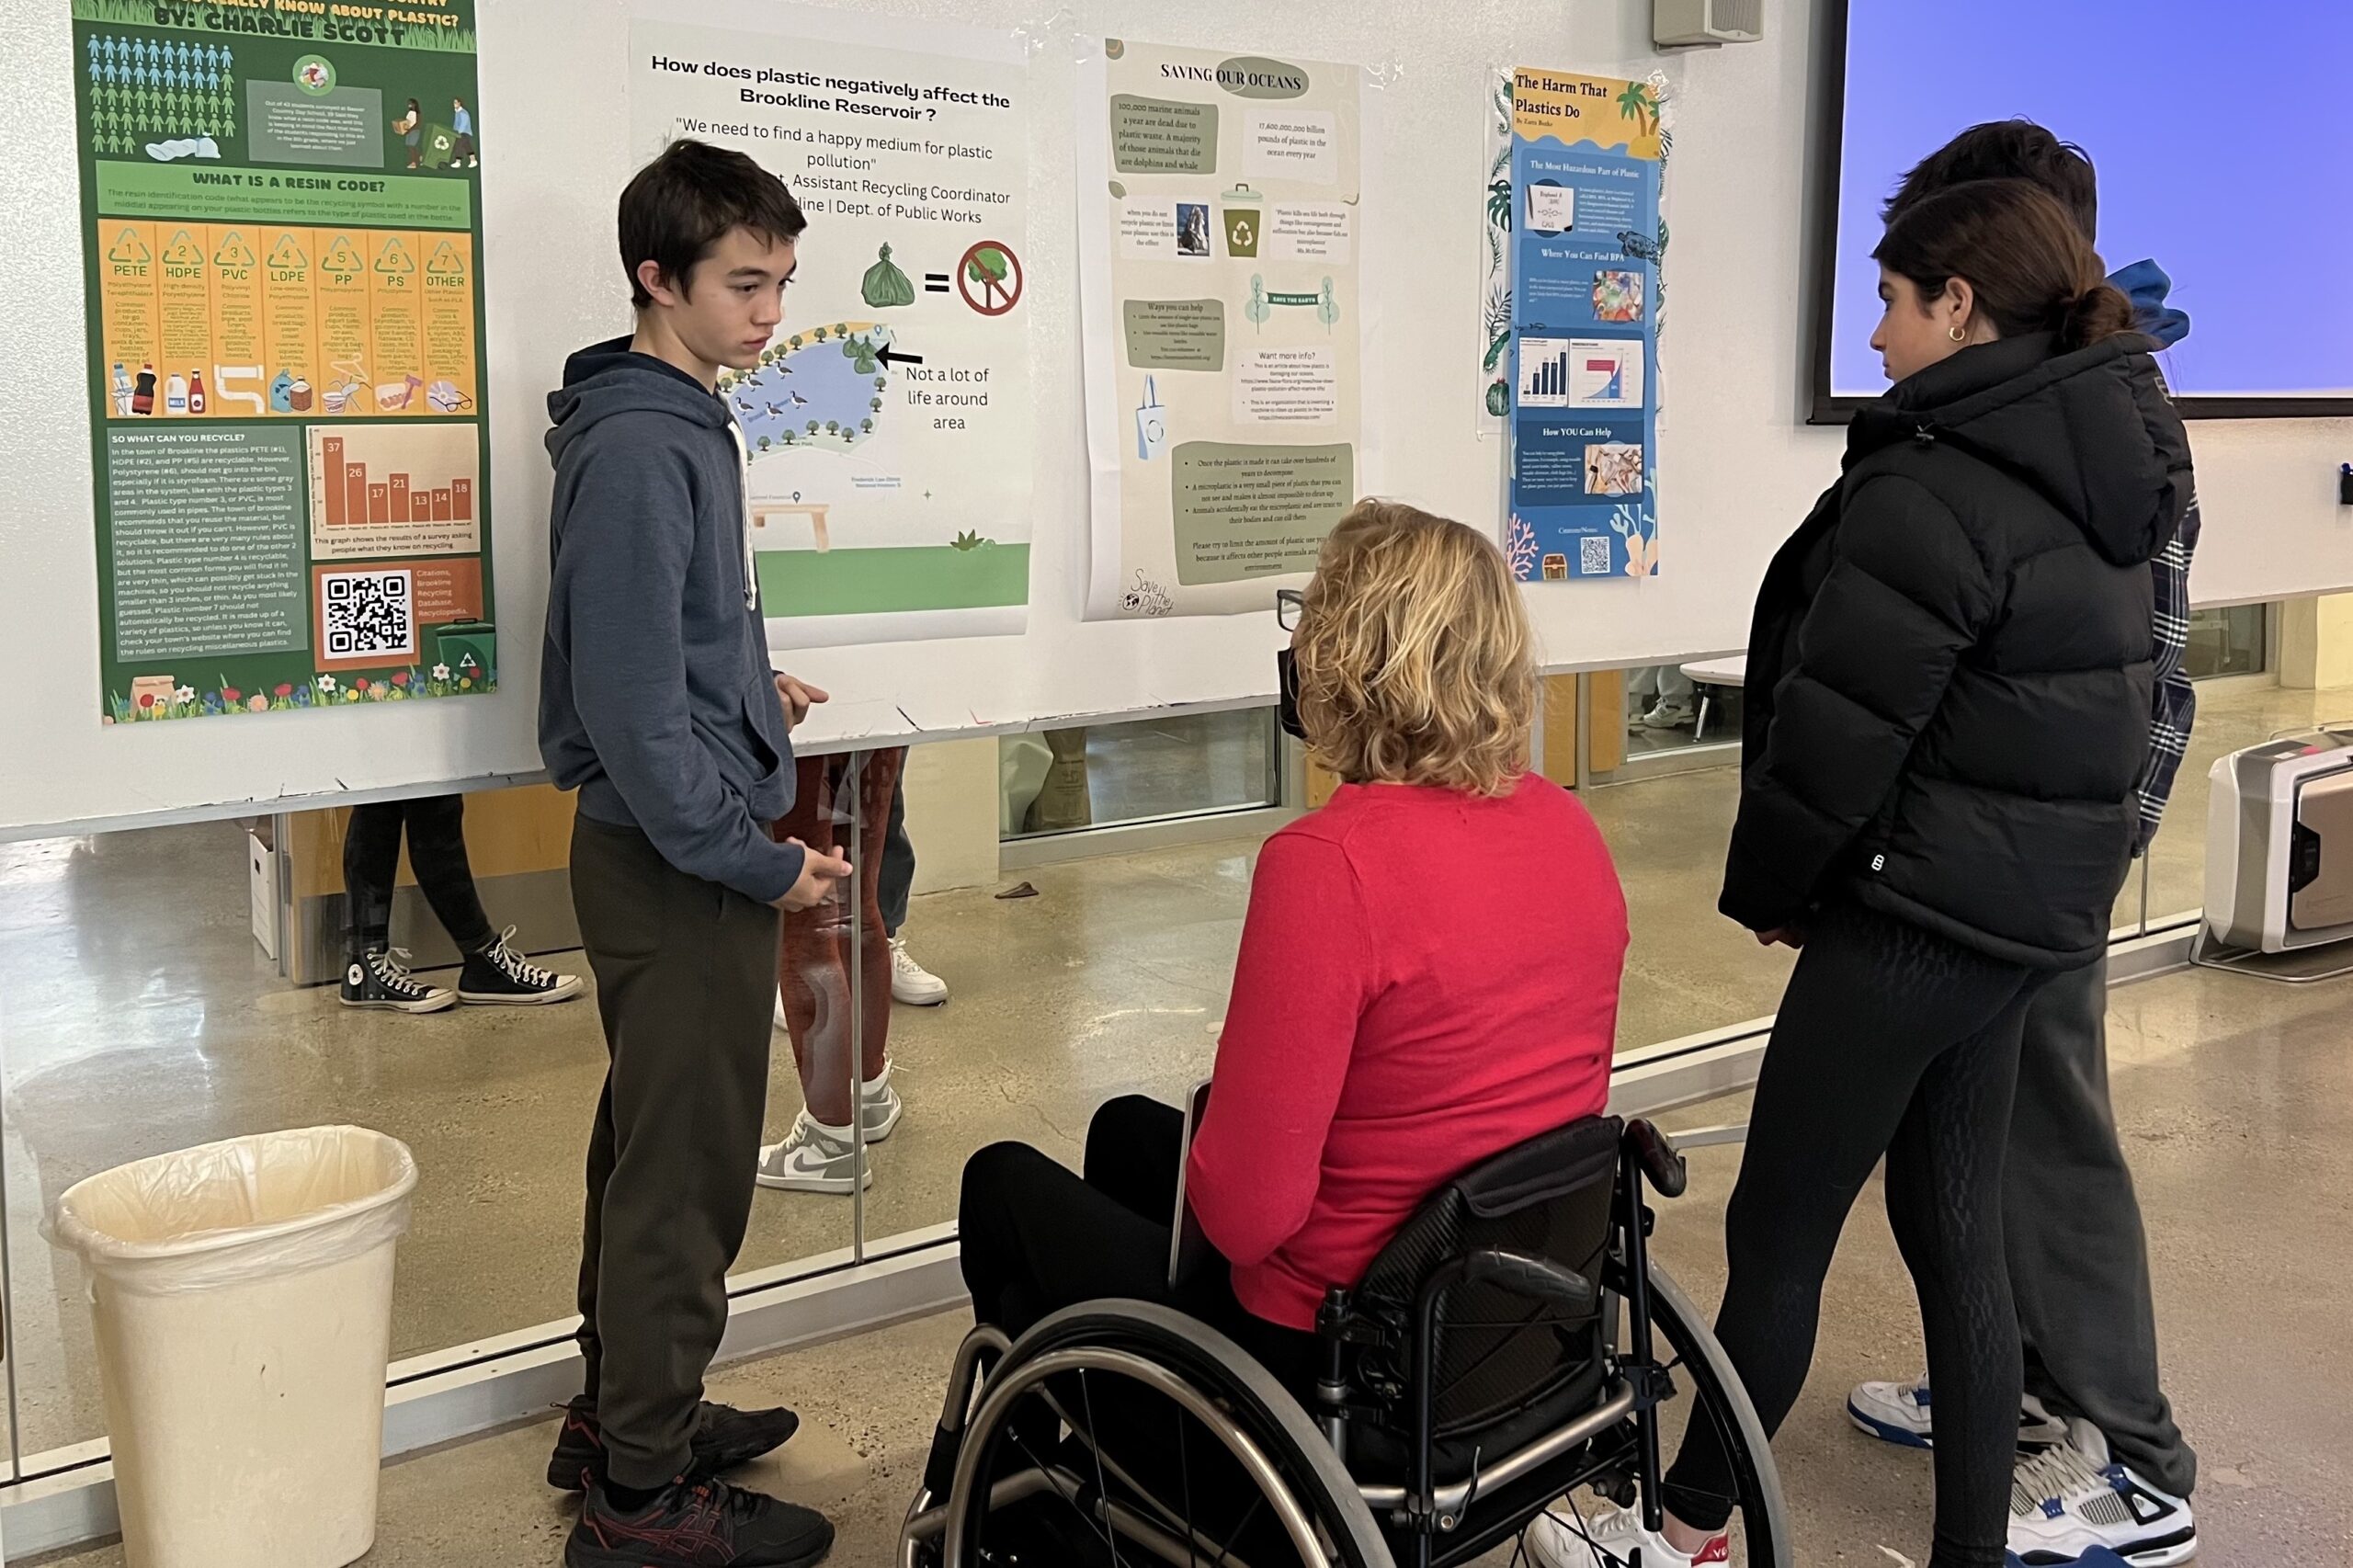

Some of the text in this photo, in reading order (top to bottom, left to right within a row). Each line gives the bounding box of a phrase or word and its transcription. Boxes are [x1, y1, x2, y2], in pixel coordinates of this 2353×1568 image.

[275, 0, 324, 14] KNOW
[330, 5, 382, 19] ABOUT
[388, 9, 459, 28] PLASTIC?
[154, 7, 404, 45] BY: CHARLIE SCOTT
[652, 56, 1010, 108] How does plastic negatively affect the
[1162, 64, 1302, 90] SAVING OUR OCEANS
[1516, 75, 1608, 97] The Harm That
[741, 88, 936, 121] Brookline Reservoir ?
[1119, 103, 1200, 116] 100,000 marine animals
[1516, 99, 1580, 118] Plastics Do
[1158, 119, 1174, 127] dead
[1176, 119, 1188, 129] due
[1306, 125, 1324, 134] billion
[676, 118, 993, 160] "We need to find a happy medium for plastic
[1119, 130, 1142, 140] plastic
[1173, 134, 1200, 144] majority
[1258, 135, 1279, 143] pounds
[1281, 136, 1288, 144] of
[1289, 136, 1308, 146] plastic
[1317, 139, 1326, 147] the
[1120, 143, 1128, 152] of
[1129, 144, 1146, 153] those
[1148, 146, 1175, 155] animals
[1190, 147, 1200, 156] die
[1286, 151, 1302, 159] every
[807, 153, 877, 170] pollution"
[1133, 158, 1163, 168] dolphins
[1165, 160, 1176, 168] and
[1179, 162, 1198, 170] whale
[1530, 160, 1543, 169] The
[1545, 162, 1562, 171] Most
[1563, 164, 1597, 175] Hazardous
[1597, 167, 1610, 176] Part
[1620, 169, 1640, 178] Plastic
[193, 173, 385, 193] WHAT IS A RESIN CODE?
[793, 174, 858, 192] Assistant
[863, 180, 927, 200] Recycling
[931, 186, 1010, 204] Coordinator
[837, 200, 874, 217] Dept.
[878, 204, 891, 217] of
[896, 205, 938, 221] Public
[941, 209, 982, 223] Works
[126, 244, 131, 254] 1
[178, 245, 187, 257] 2
[231, 247, 238, 258] 3
[282, 250, 290, 260] 4
[337, 252, 347, 263] 5
[390, 254, 398, 265] 6
[1541, 249, 1624, 262] Where You Can Find BPA
[441, 256, 449, 266] 7
[114, 266, 147, 277] PETE
[165, 267, 201, 278] HDPE
[222, 269, 248, 280] PVC
[271, 271, 305, 282] LDPE
[335, 275, 352, 285] PP
[388, 277, 404, 287] PS
[426, 277, 464, 287] OTHER
[1148, 303, 1165, 312] Ways
[1190, 303, 1203, 312] help
[906, 368, 990, 382] Not a lot of
[908, 391, 988, 406] life around
[934, 418, 965, 429] area
[200, 434, 245, 442] RECYCLE?
[1543, 427, 1612, 438] How YOU Can Help
[327, 443, 340, 452] 37
[348, 469, 362, 478] 26
[393, 480, 405, 488] 21
[456, 483, 468, 493] 18
[372, 489, 384, 498] 17
[435, 493, 448, 502] 14
[415, 496, 427, 506] 13
[331, 537, 351, 546] graph
[451, 532, 472, 541] asking
[376, 544, 392, 552] they
[423, 542, 454, 551] recycling
[417, 579, 451, 587] Brookline
[1131, 569, 1158, 594] Save
[417, 588, 453, 597] Recycling
